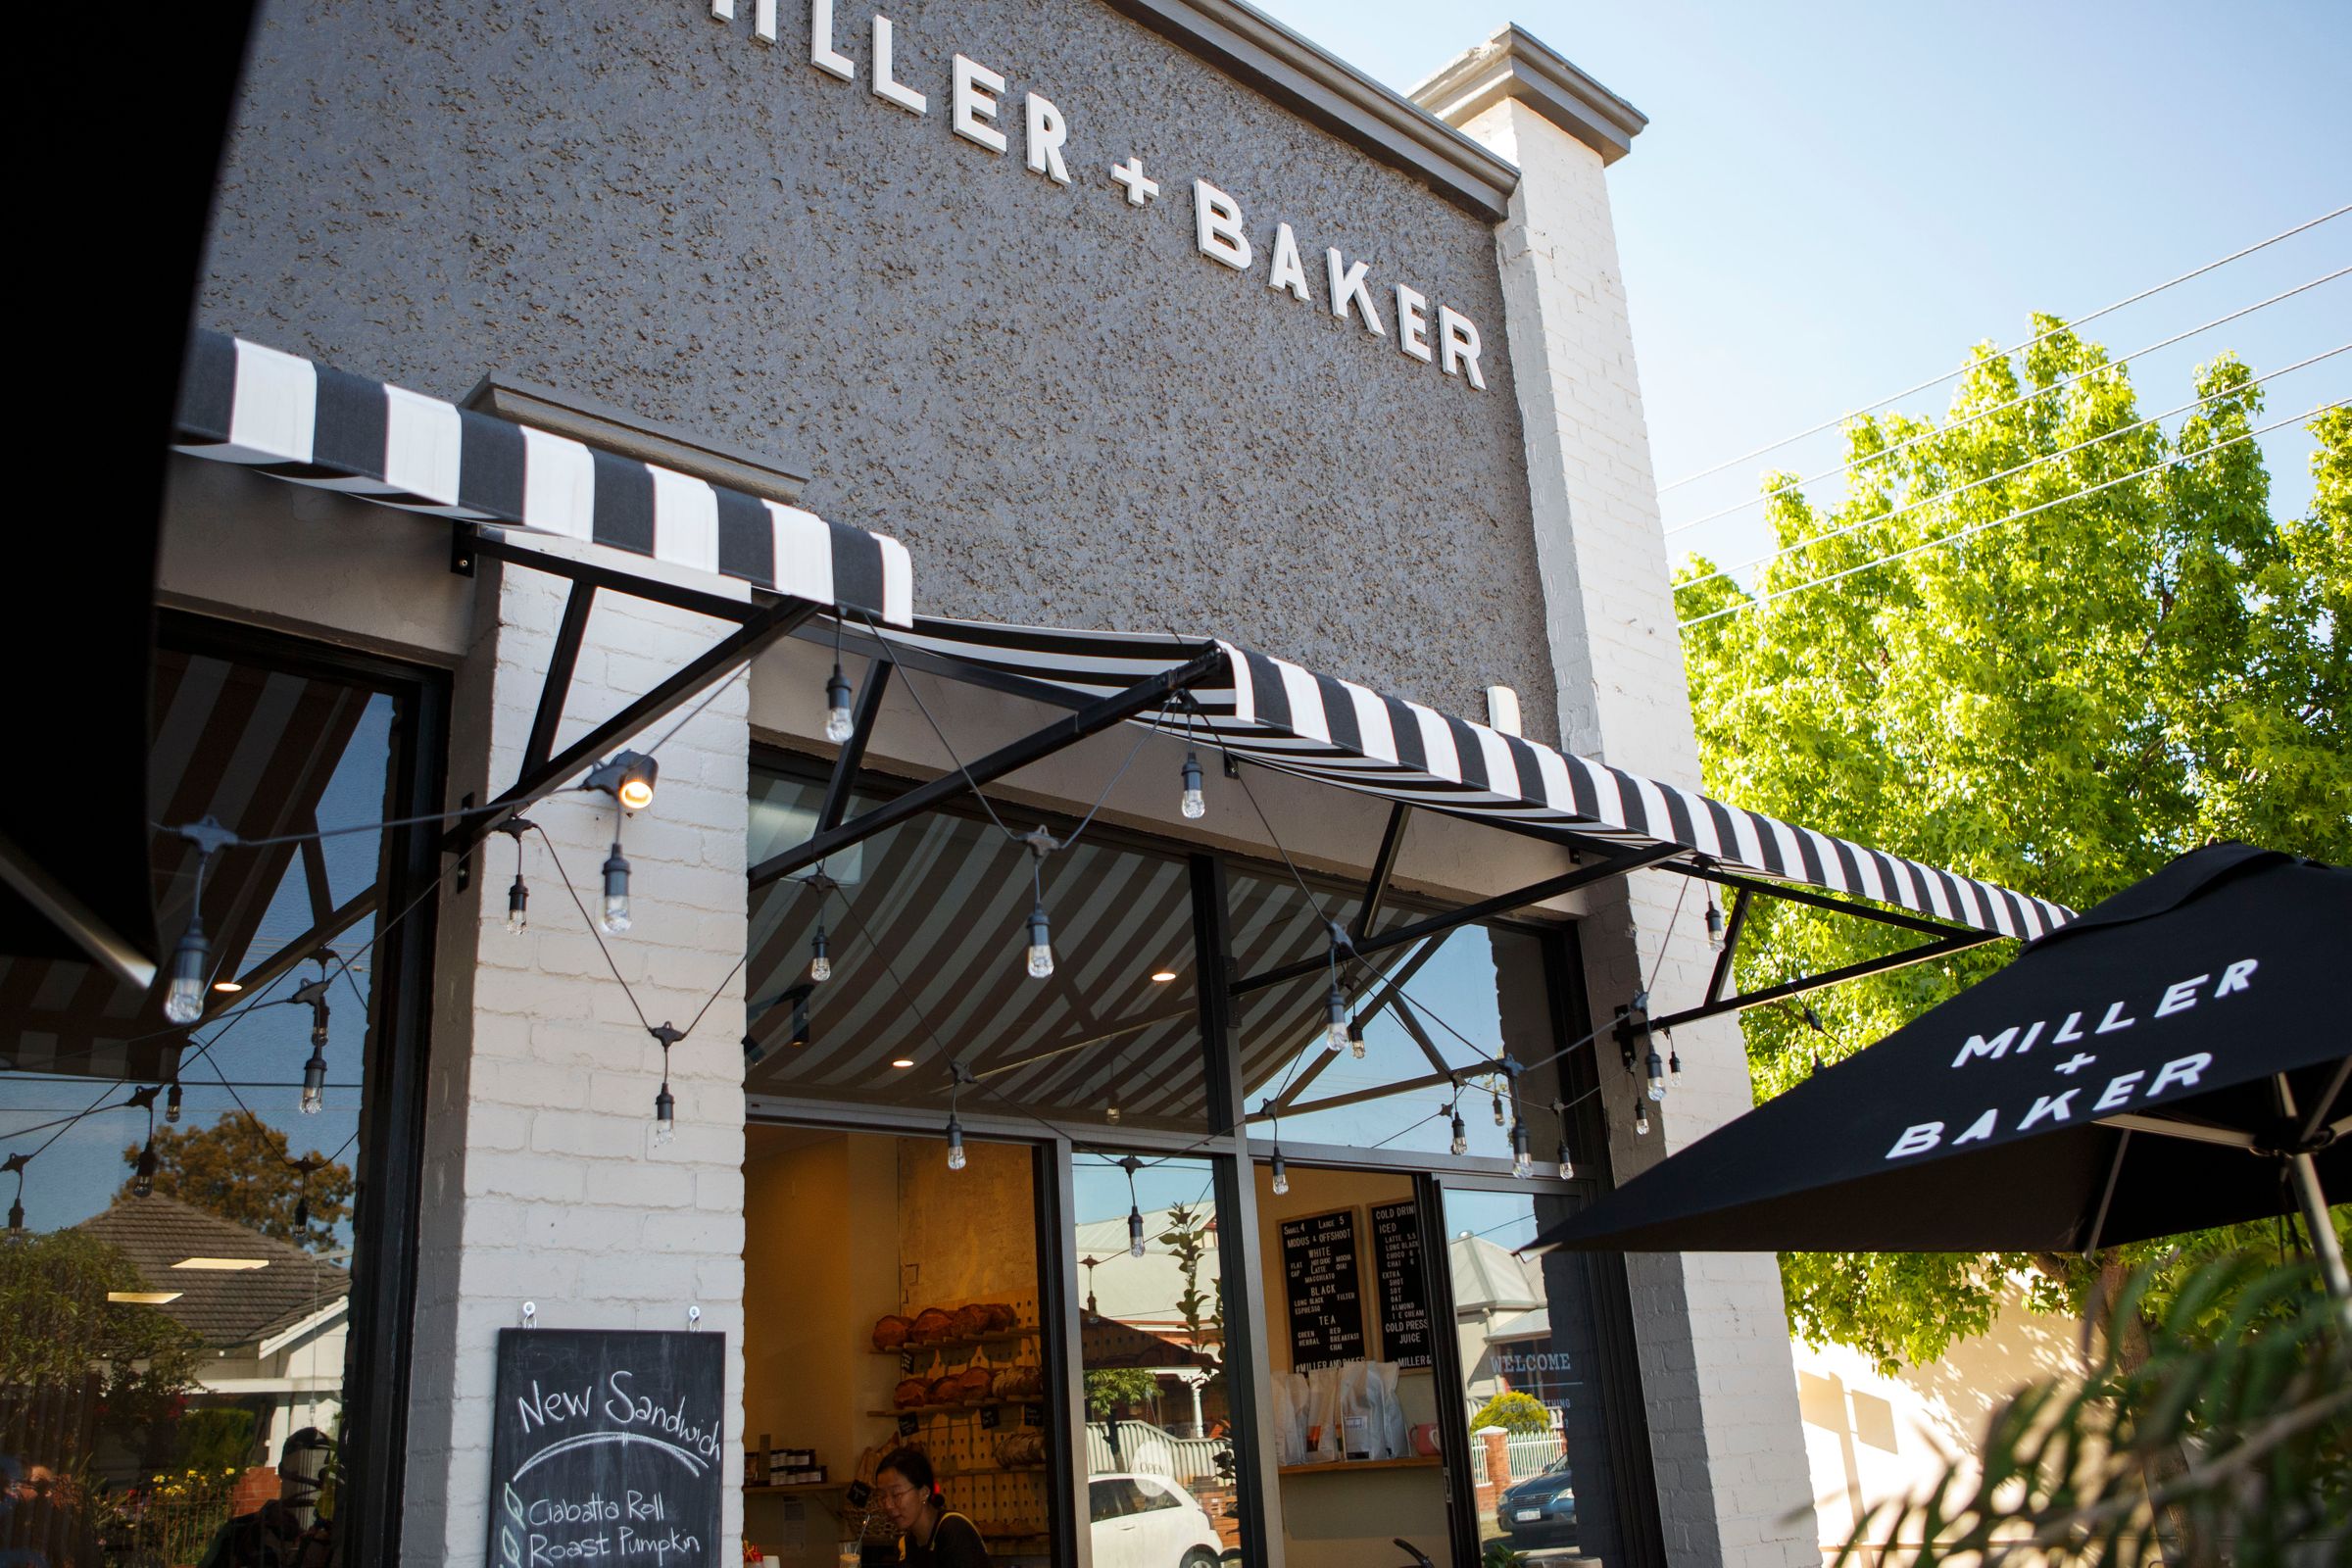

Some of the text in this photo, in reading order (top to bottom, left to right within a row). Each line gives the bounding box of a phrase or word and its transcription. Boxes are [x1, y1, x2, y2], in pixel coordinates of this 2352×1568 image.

[1110, 156, 1159, 207] +
[1194, 178, 1486, 391] BAKER
[1951, 957, 2259, 1067] MILLER
[2054, 1052, 2096, 1074] +
[1885, 1052, 2213, 1160] BAKER
[1376, 1204, 1415, 1220] COLD DRIN
[1300, 1223, 1305, 1233] 4
[1339, 1215, 1345, 1225] 5
[1379, 1222, 1396, 1235] ICED
[1287, 1236, 1310, 1249] MODUS
[1318, 1228, 1351, 1243] OFFSHOOT
[1385, 1235, 1402, 1244] LATTE
[1308, 1247, 1332, 1258] WHITE
[1386, 1243, 1400, 1252] LONG
[1304, 1272, 1336, 1284] MACCHIATO
[1382, 1270, 1400, 1279] EXTRA
[1310, 1284, 1337, 1297] BLACK
[1294, 1298, 1307, 1307] LONG
[1337, 1292, 1355, 1301] FILTER
[1392, 1301, 1415, 1311] ALMOND
[1294, 1305, 1321, 1315] ESPRESSO
[1403, 1309, 1425, 1319] CREAM
[1318, 1314, 1337, 1326] TEA
[1385, 1322, 1404, 1333] COLD
[1298, 1331, 1315, 1340] GREEN
[1298, 1333, 1360, 1348] HERBAL BREAKFAST
[1399, 1332, 1421, 1345] JUICE
[1490, 1352, 1571, 1373] WELCOME
[517, 1370, 721, 1460] New Sandwich
[1140, 1462, 1165, 1475] OPEN
[528, 1490, 665, 1526] Ciabatta Roll
[530, 1526, 701, 1568] Roast Pumpkin
